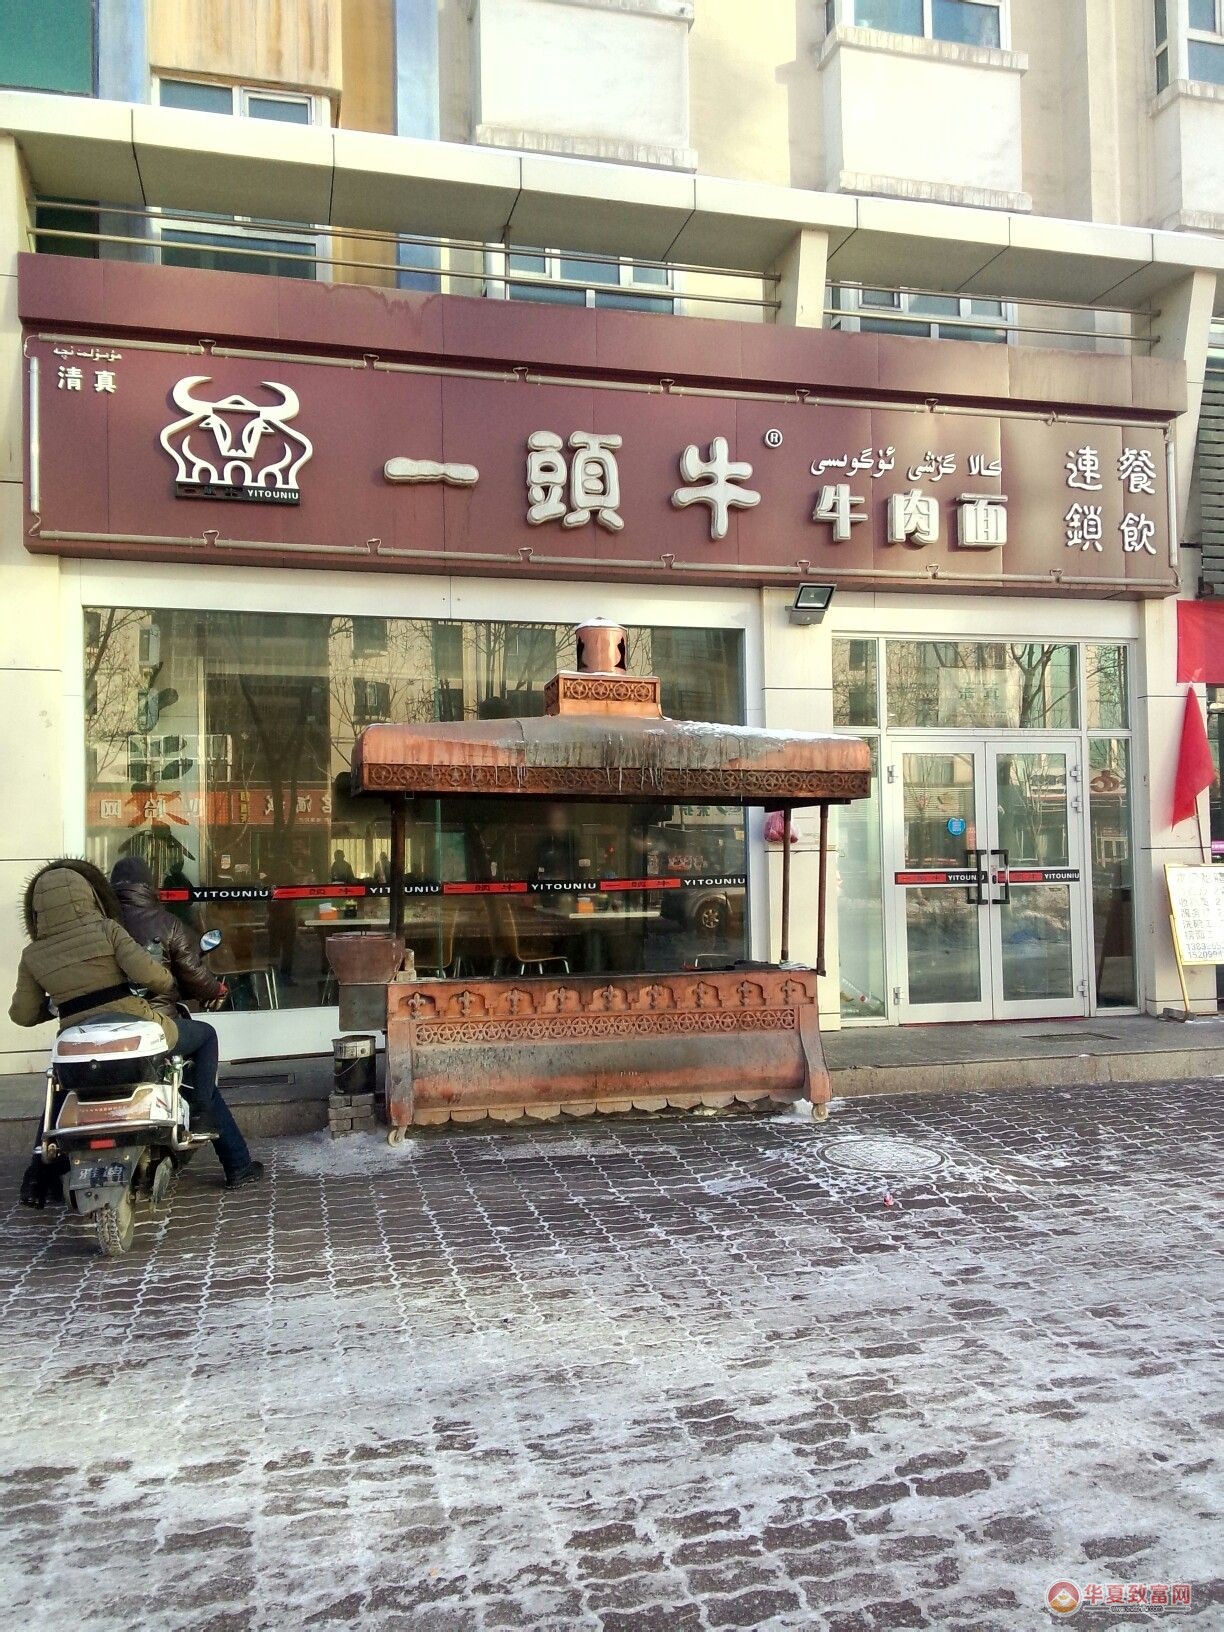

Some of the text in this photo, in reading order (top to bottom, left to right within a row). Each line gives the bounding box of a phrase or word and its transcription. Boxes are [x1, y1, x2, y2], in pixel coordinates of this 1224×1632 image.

[58, 365, 117, 393] 清真
[384, 430, 761, 540] 一頭牛
[247, 489, 299, 500] YITOUNIU
[813, 484, 1008, 547] 牛肉面
[531, 882, 597, 891] YITOUNIU
[683, 877, 746, 886] YITOUNIU
[193, 890, 269, 899] YITOUNIU
[369, 885, 439, 895] YITUNIU
